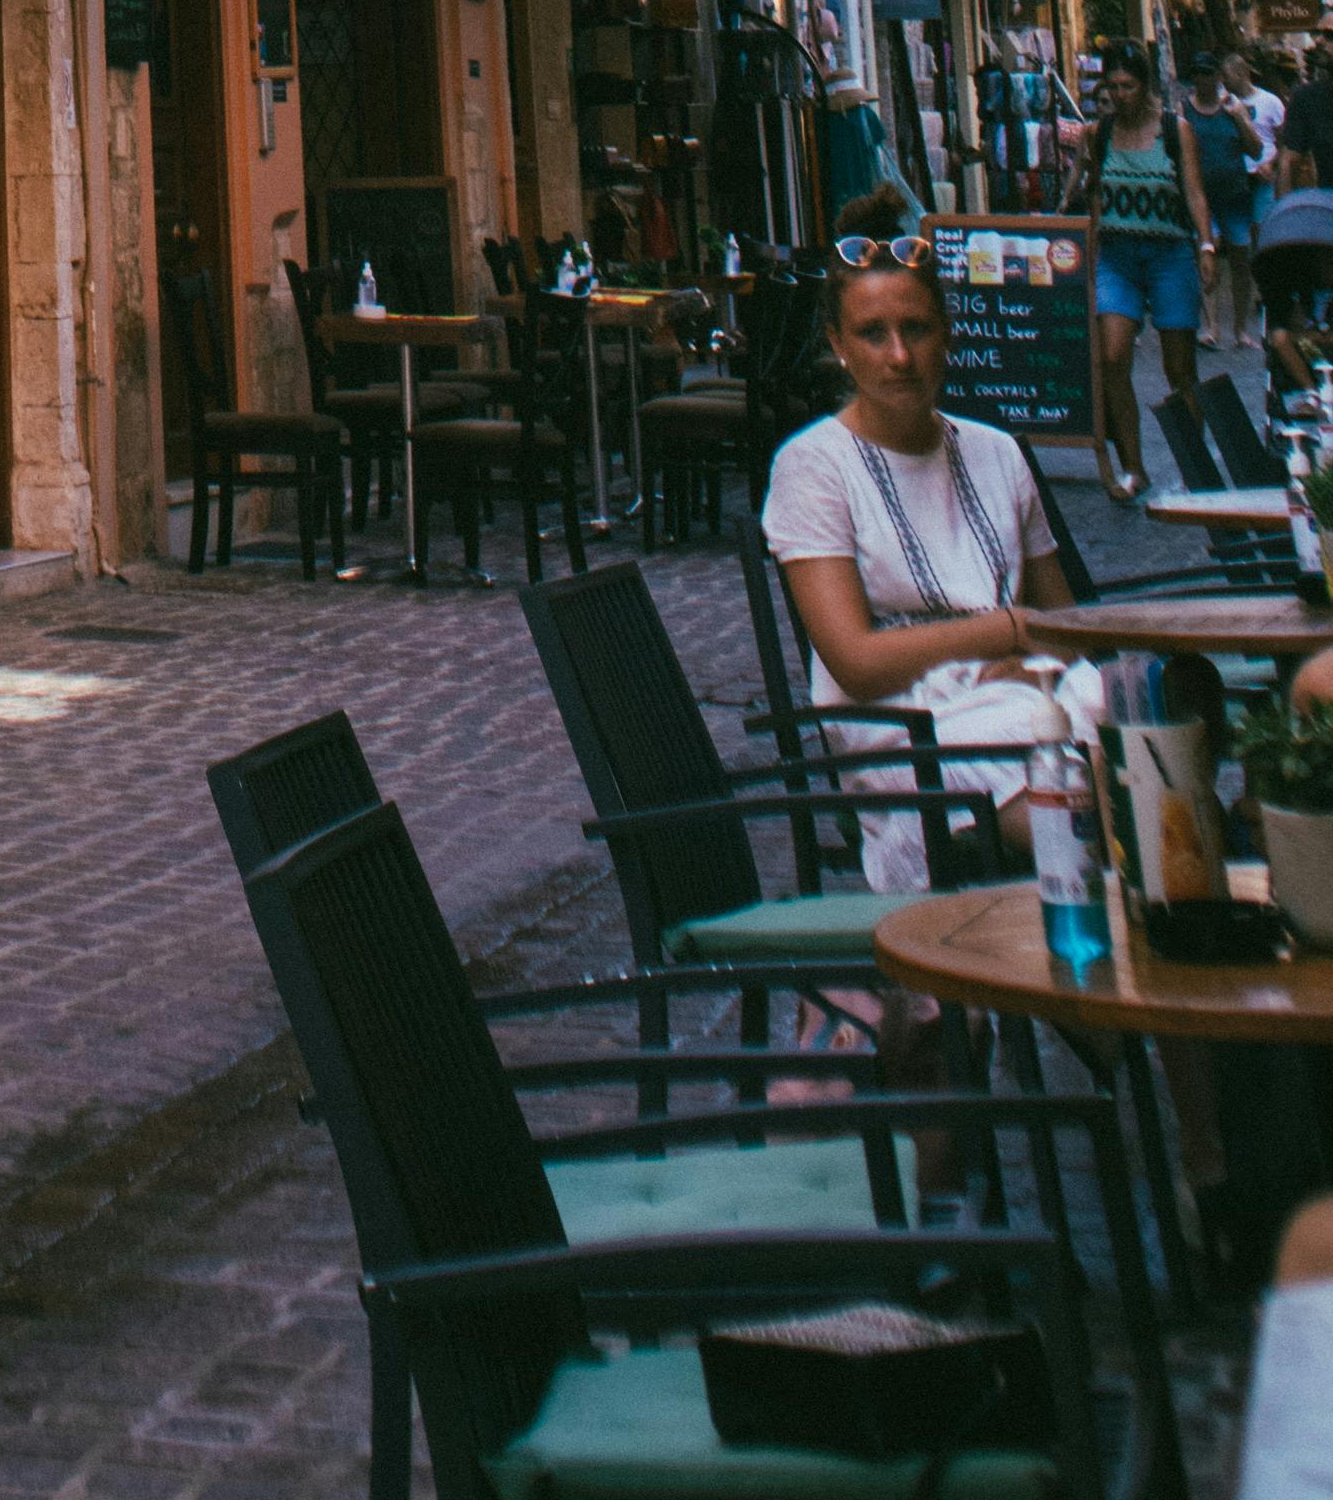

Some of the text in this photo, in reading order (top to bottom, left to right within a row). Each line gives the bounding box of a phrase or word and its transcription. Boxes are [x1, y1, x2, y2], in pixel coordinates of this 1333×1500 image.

[998, 294, 1033, 315] beer
[1007, 323, 1040, 339] beer
[945, 348, 1002, 368] WINE
[997, 403, 1070, 419] TAKE AWAY
